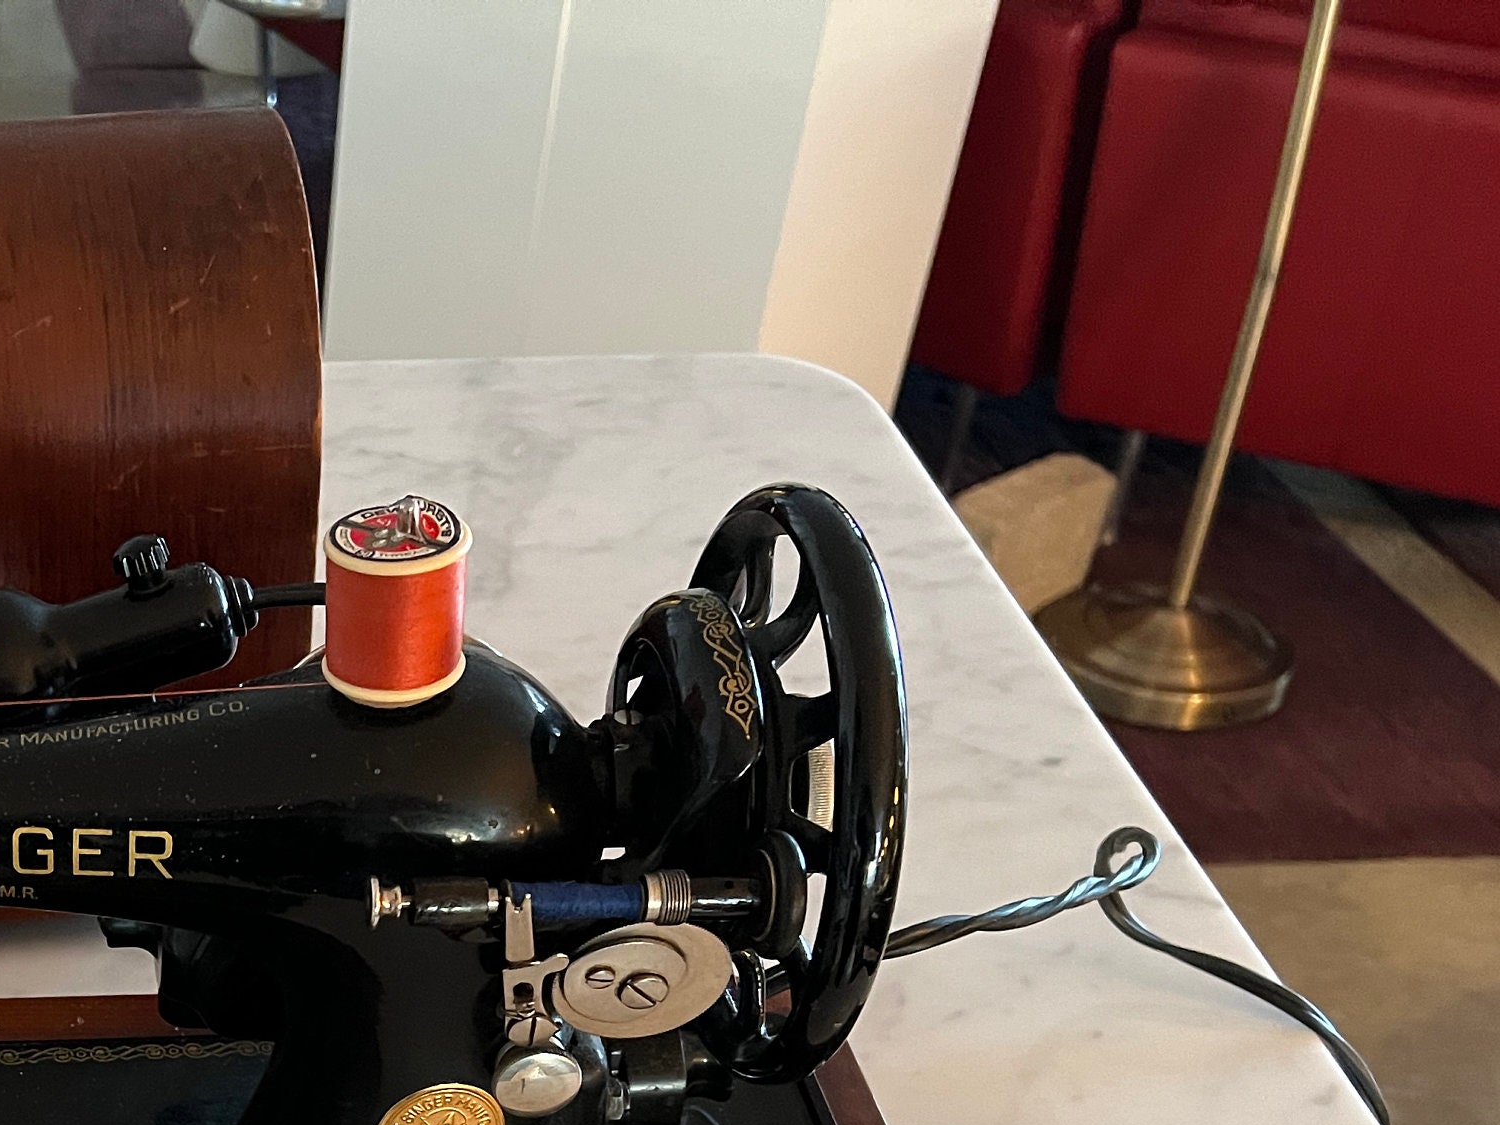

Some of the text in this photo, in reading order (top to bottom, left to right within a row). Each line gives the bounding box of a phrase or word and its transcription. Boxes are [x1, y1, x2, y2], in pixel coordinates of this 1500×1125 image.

[20, 708, 200, 747] MANUFACTURING
[209, 699, 250, 718] CO.
[0, 885, 39, 900] M.R.
